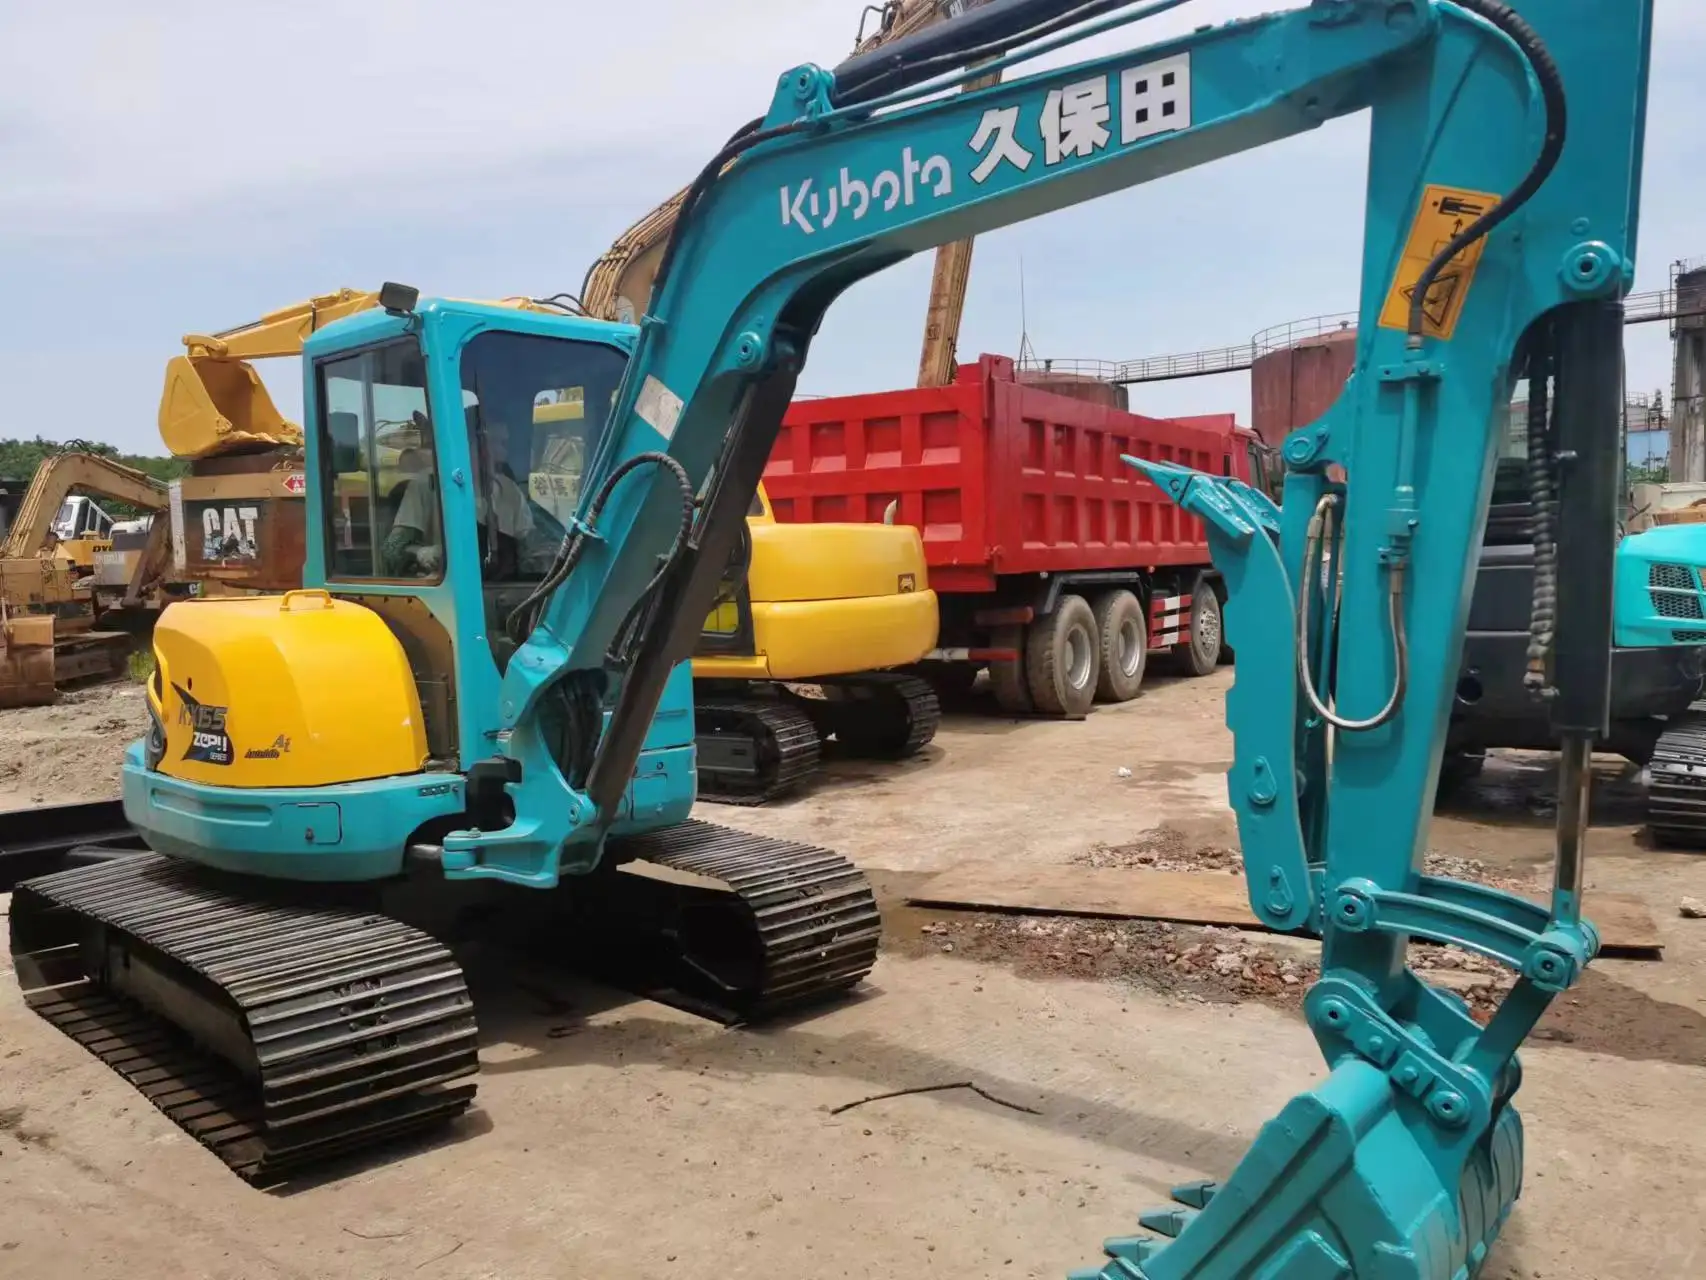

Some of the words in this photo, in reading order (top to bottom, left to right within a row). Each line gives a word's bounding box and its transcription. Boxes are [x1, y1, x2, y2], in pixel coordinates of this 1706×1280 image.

[780, 146, 953, 234] Kubota
[968, 51, 1192, 184] 久保田
[202, 507, 258, 560] CAT
